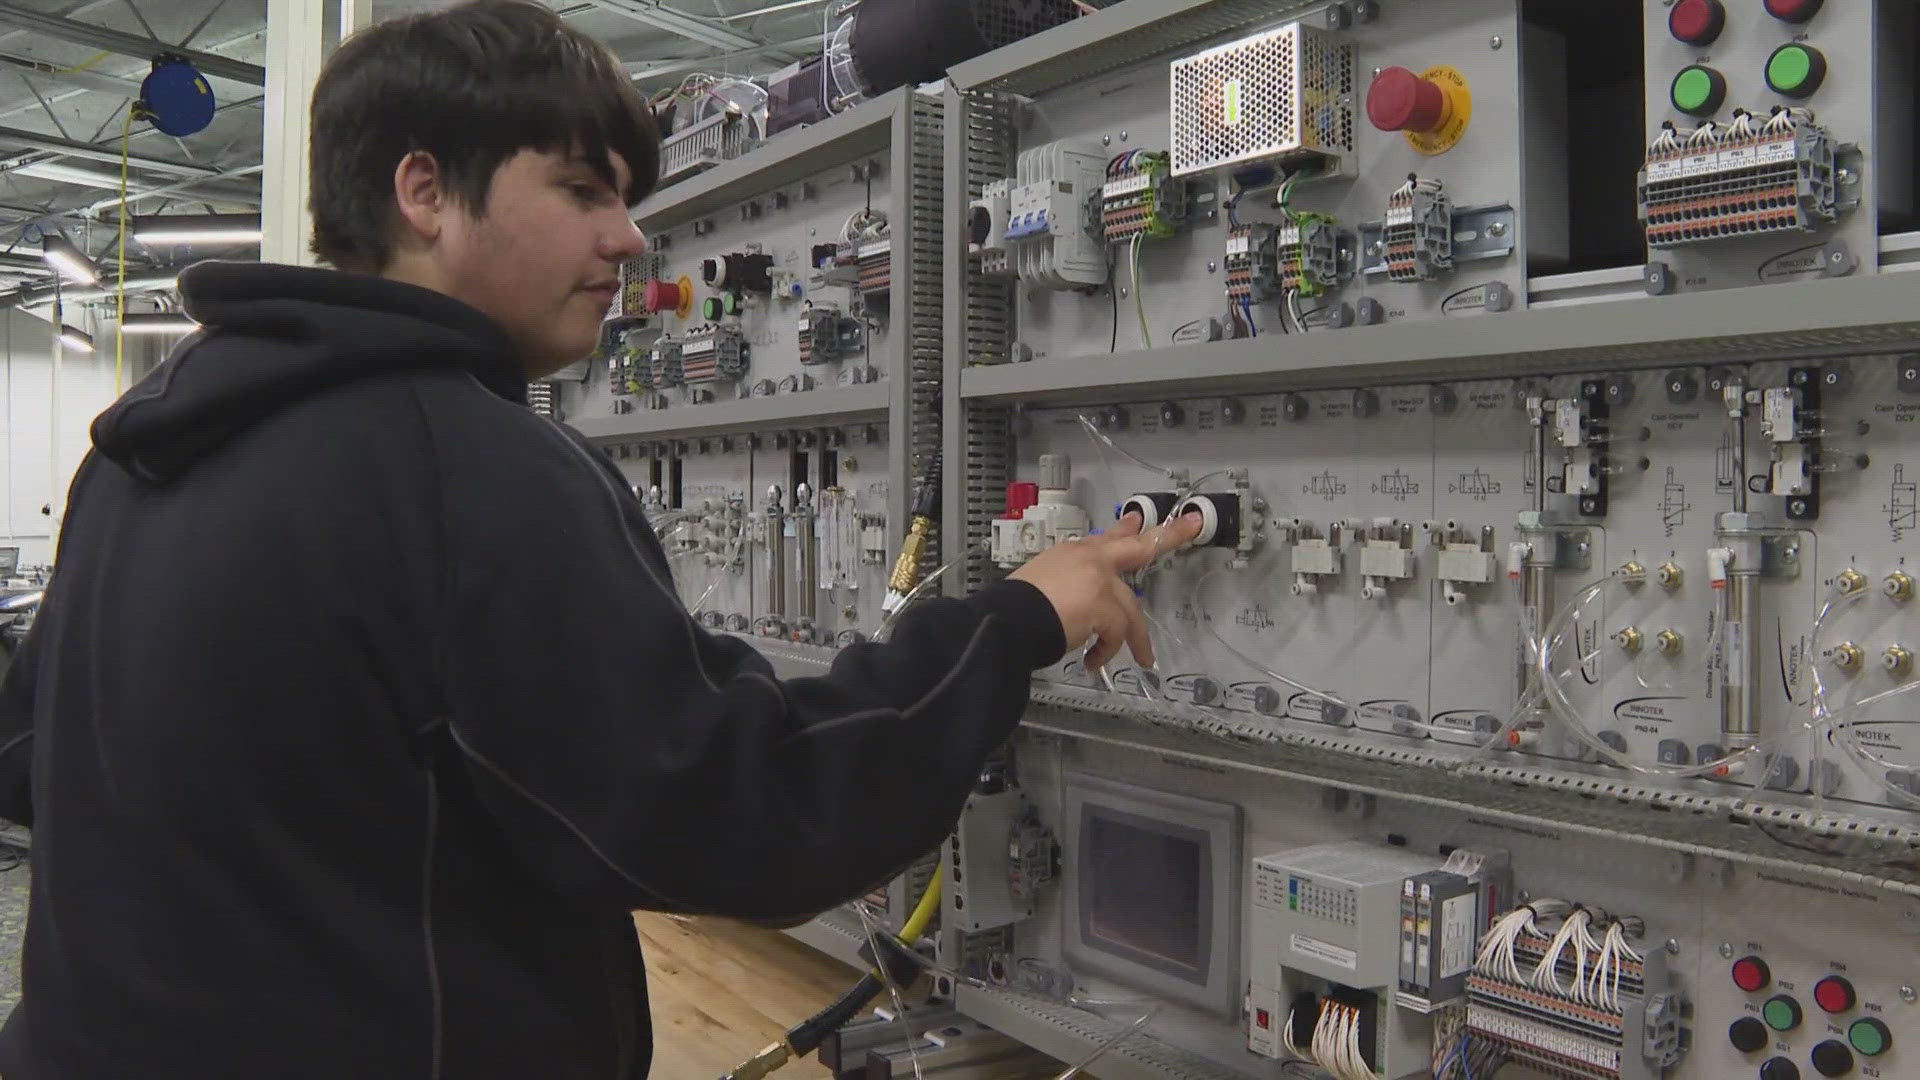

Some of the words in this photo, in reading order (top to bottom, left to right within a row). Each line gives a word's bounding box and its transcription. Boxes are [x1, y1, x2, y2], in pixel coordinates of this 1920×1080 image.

[1895, 414, 1915, 422] DCV
[1630, 705, 1664, 715] INNOTEK
[1830, 960, 1847, 971] PB4
[1778, 980, 1794, 990] PB2
